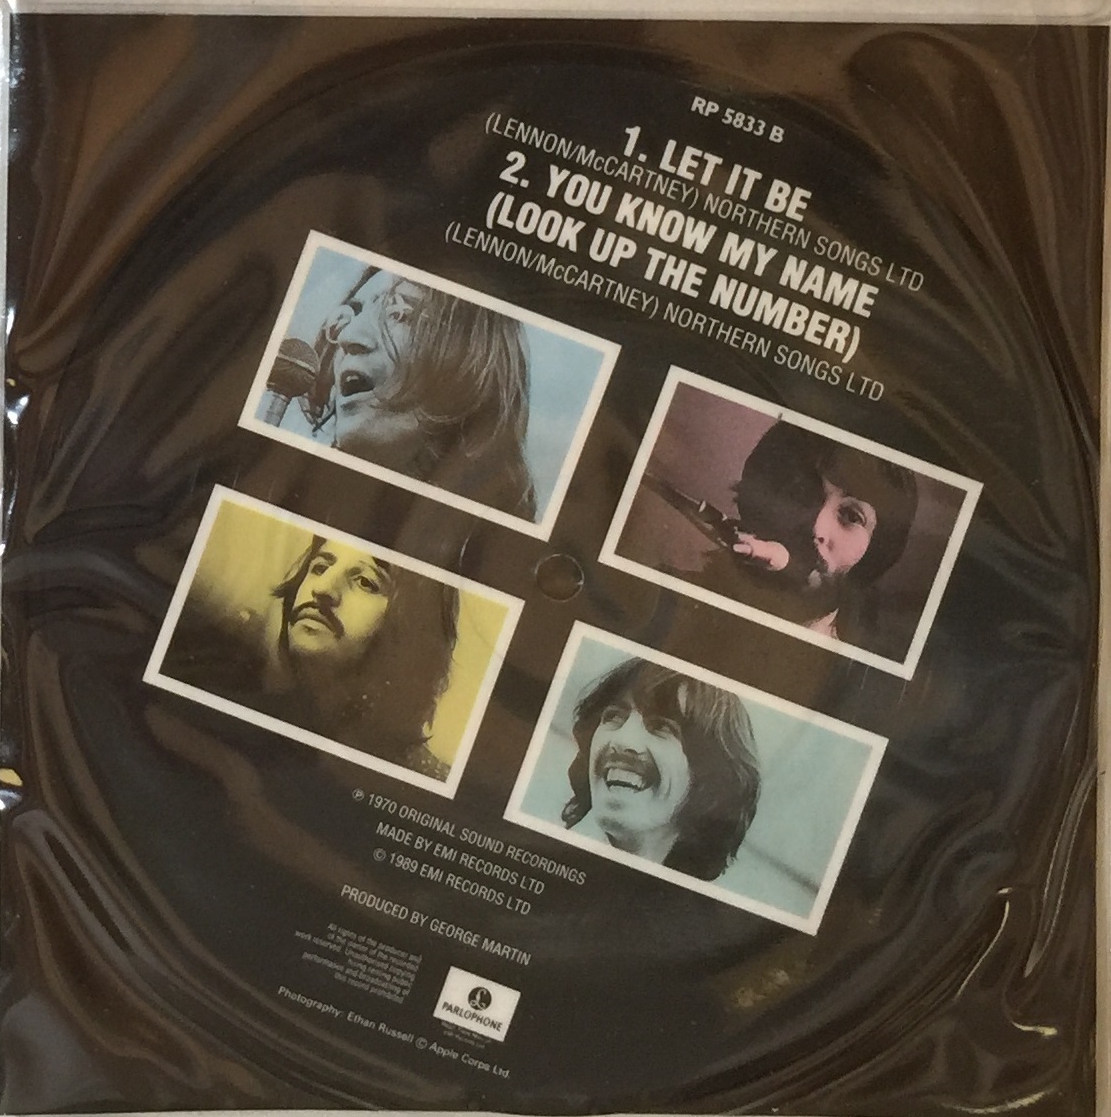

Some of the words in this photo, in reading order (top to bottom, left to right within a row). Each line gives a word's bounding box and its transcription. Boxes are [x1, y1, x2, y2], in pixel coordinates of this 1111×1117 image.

[690, 96, 719, 116] RP
[721, 107, 766, 136] 5833
[768, 125, 784, 143] B
[485, 112, 699, 209] (LENNON/McCARTNEY)
[703, 192, 811, 249] NORTHERN
[813, 235, 882, 276] SONGS
[885, 262, 924, 291] LTD
[623, 125, 647, 162] 1.
[659, 139, 723, 186] LET
[724, 163, 762, 201] IT
[764, 178, 812, 222] BE
[486, 191, 586, 252] (LOOK
[589, 227, 637, 267] UP
[643, 246, 707, 298] THE
[708, 273, 860, 362] NUMBER)
[499, 150, 529, 188] 2.
[546, 164, 613, 215] YOU
[614, 192, 717, 254] KNOW
[718, 231, 778, 276] MY
[778, 254, 879, 318] NAME
[445, 221, 659, 318] (LENNON/McCARTNEY)
[663, 301, 771, 358] NORTHERN
[773, 344, 843, 385] SONGS
[845, 371, 884, 401] LTD
[368, 793, 397, 814] 1970
[398, 805, 455, 837] ORIGINAL
[459, 827, 504, 854] SOUND
[505, 844, 586, 885] RECORDINGS
[375, 821, 413, 845] MADE
[413, 835, 433, 851] BY
[432, 842, 458, 861] EMI
[458, 852, 519, 885] RECORDS
[519, 875, 545, 894] LTD
[390, 852, 418, 873] 1989
[419, 863, 444, 882] EMI
[445, 872, 505, 905] RECORDS
[505, 896, 531, 915] LTD
[340, 884, 409, 920] PRODUCED
[409, 910, 429, 927] BY
[429, 918, 480, 947] GEORGE
[481, 937, 531, 965] MARTIN
[442, 1001, 502, 1032] PARLOPHONE
